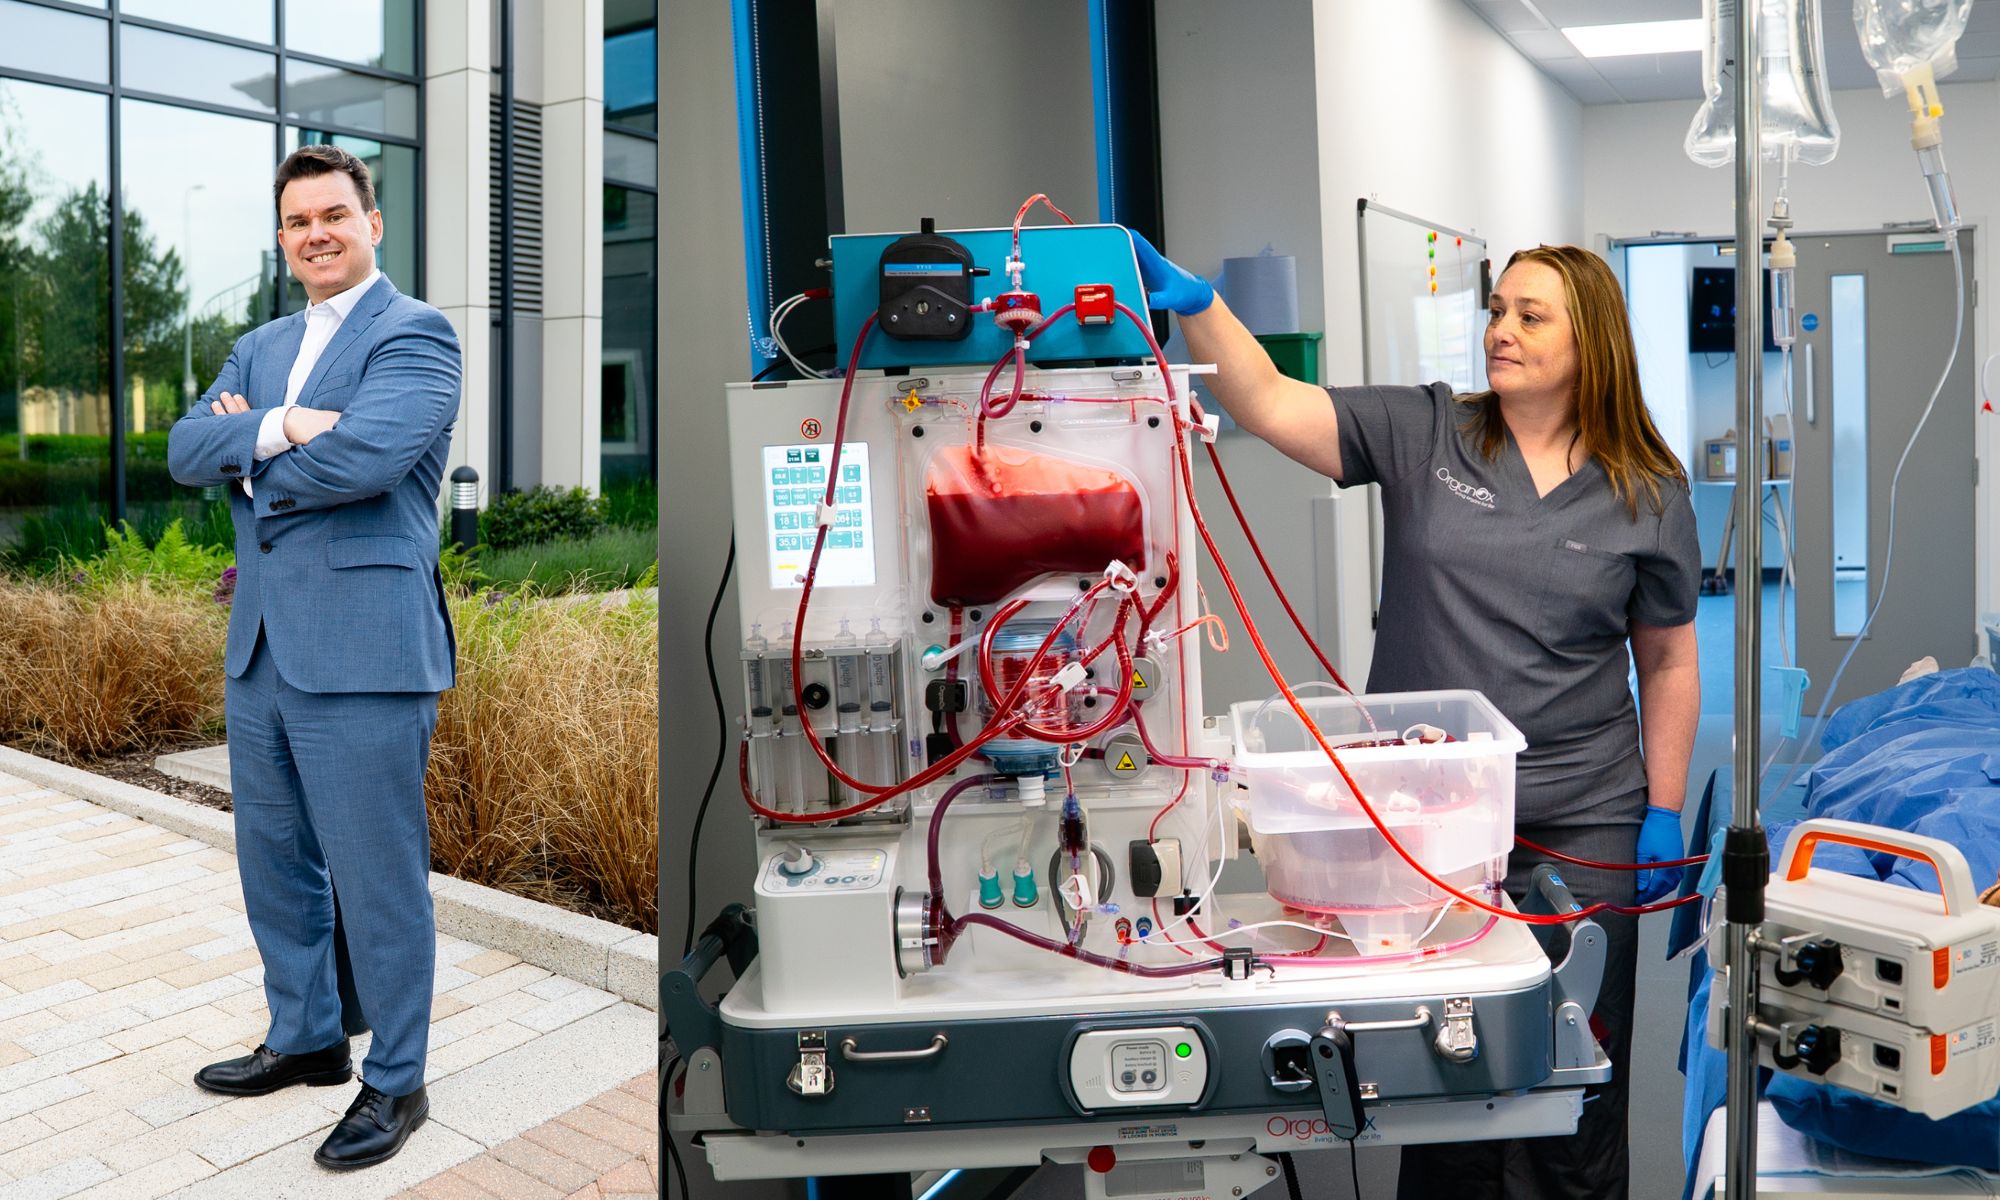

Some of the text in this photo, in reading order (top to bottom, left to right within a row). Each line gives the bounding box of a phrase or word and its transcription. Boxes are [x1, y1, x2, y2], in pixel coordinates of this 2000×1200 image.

[1436, 467, 1496, 503] OrganOx
[1267, 1115, 1377, 1140] Orgax
[1314, 1134, 1333, 1143] living
